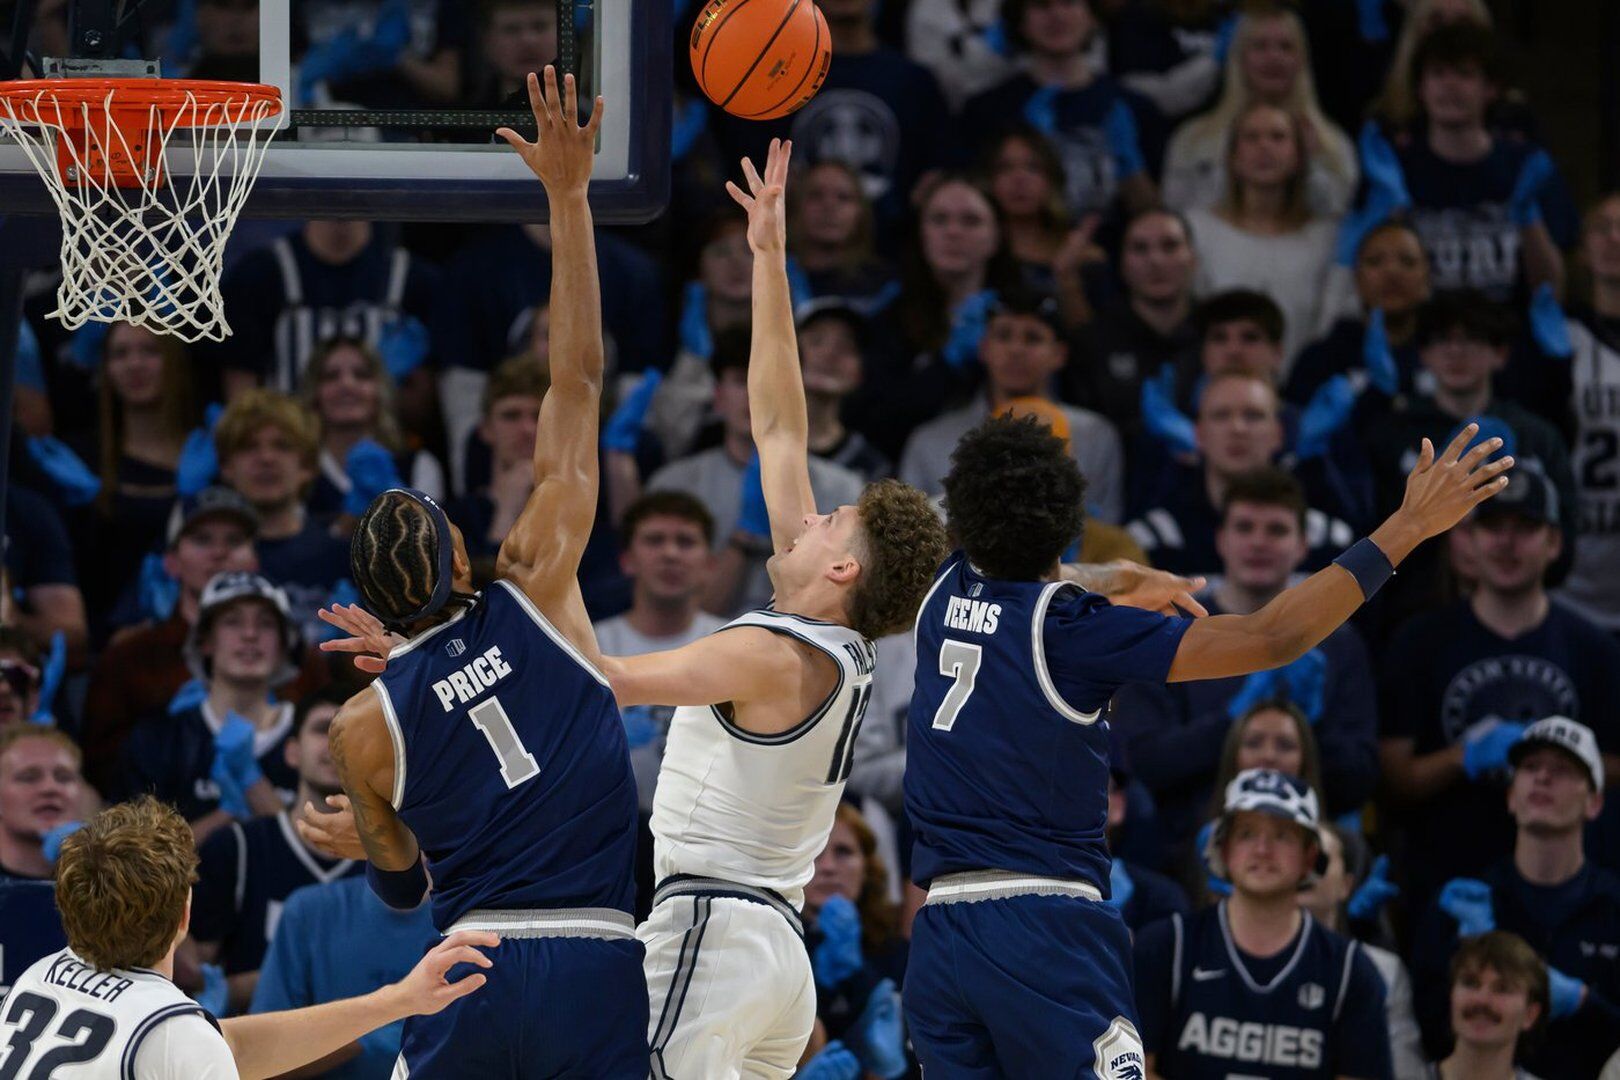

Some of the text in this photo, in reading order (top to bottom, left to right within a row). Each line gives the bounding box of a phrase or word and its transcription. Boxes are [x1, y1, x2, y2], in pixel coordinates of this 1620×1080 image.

[431, 645, 513, 713] PRICE
[931, 638, 983, 732] 7
[467, 695, 541, 790] 1
[44, 953, 133, 1003] KELLER
[0, 990, 118, 1080] 32
[1177, 1010, 1325, 1070] AGGIES
